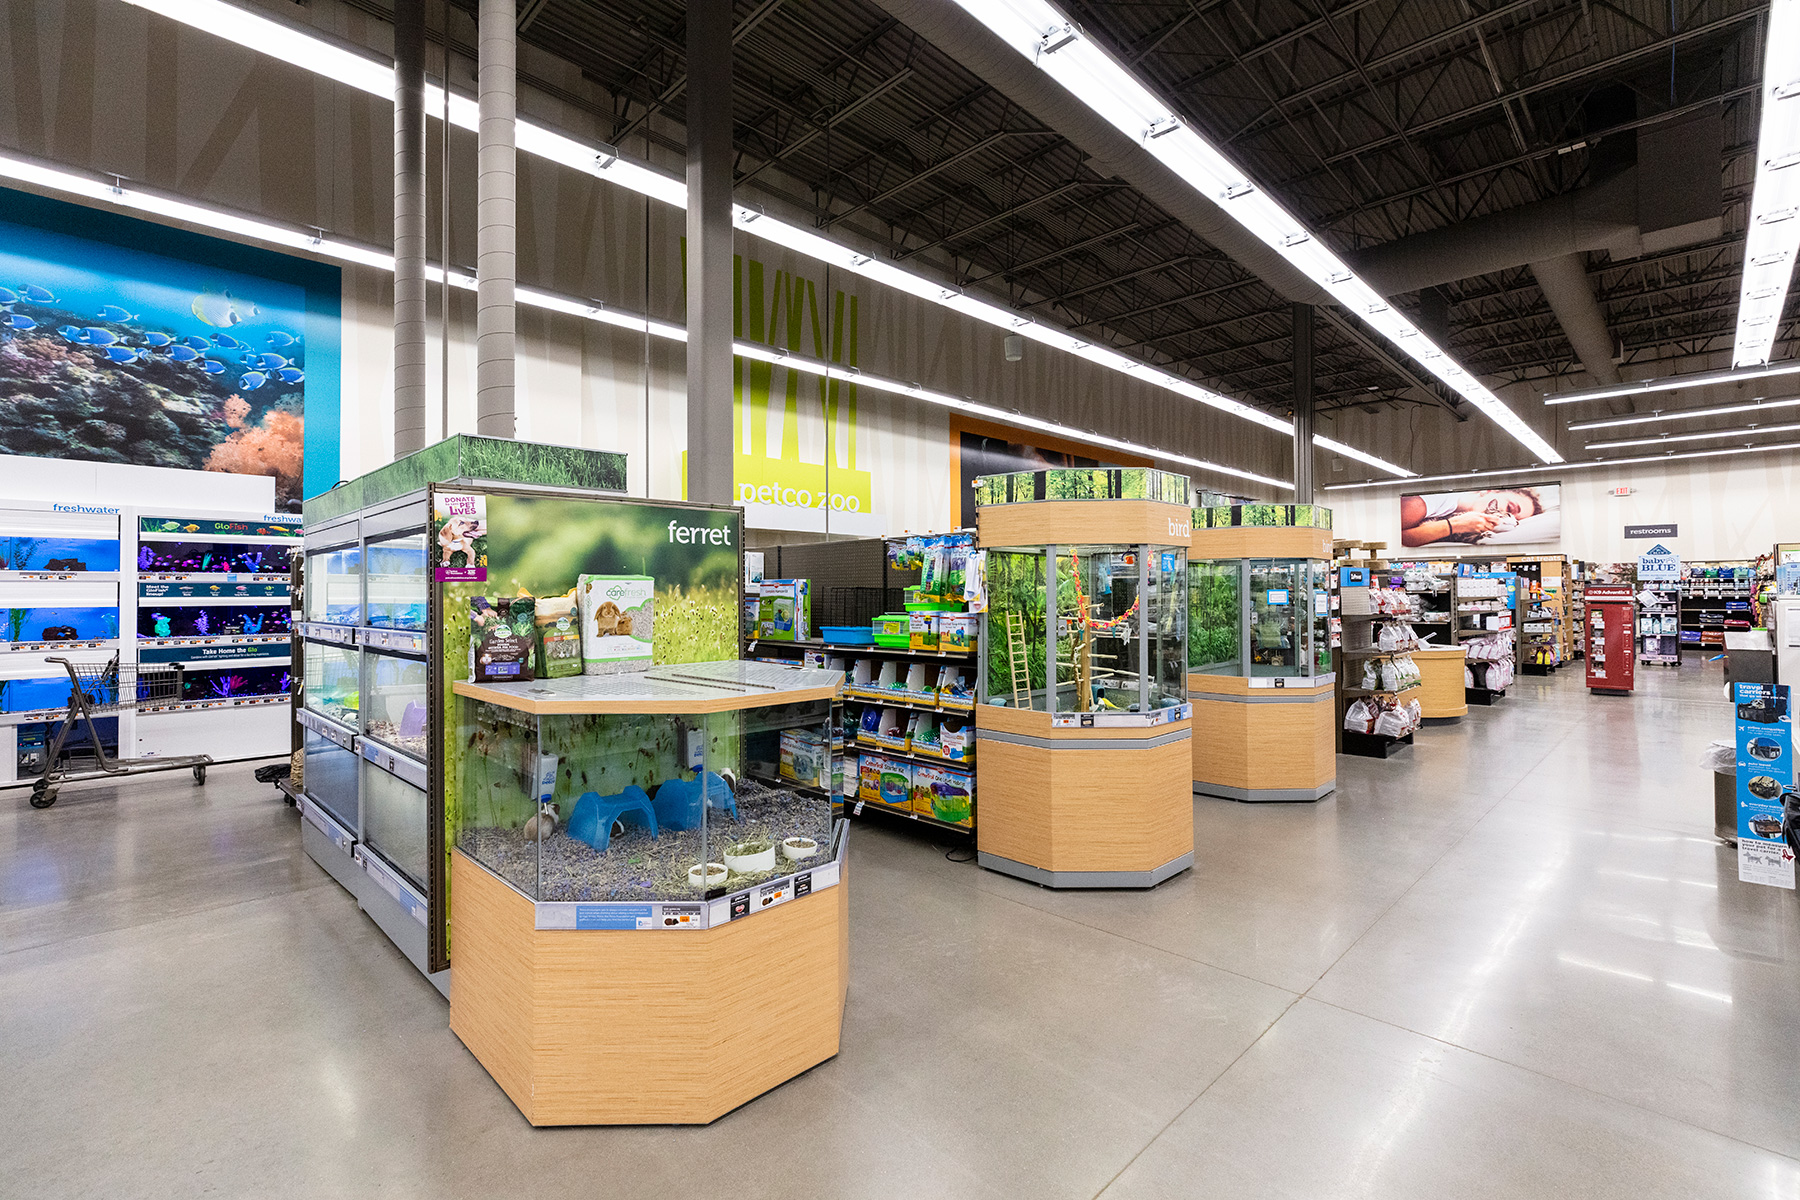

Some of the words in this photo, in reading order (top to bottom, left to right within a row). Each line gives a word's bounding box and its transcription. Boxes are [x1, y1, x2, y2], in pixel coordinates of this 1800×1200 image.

[738, 482, 812, 508] petco
[817, 492, 861, 513] zoo
[53, 503, 120, 514] freshwater
[263, 514, 303, 524] freshwa
[214, 522, 248, 531] GloFish
[1168, 517, 1190, 538] bird
[1630, 527, 1671, 535] restrooms
[668, 520, 731, 545] ferret
[1641, 564, 1676, 572] BLUE
